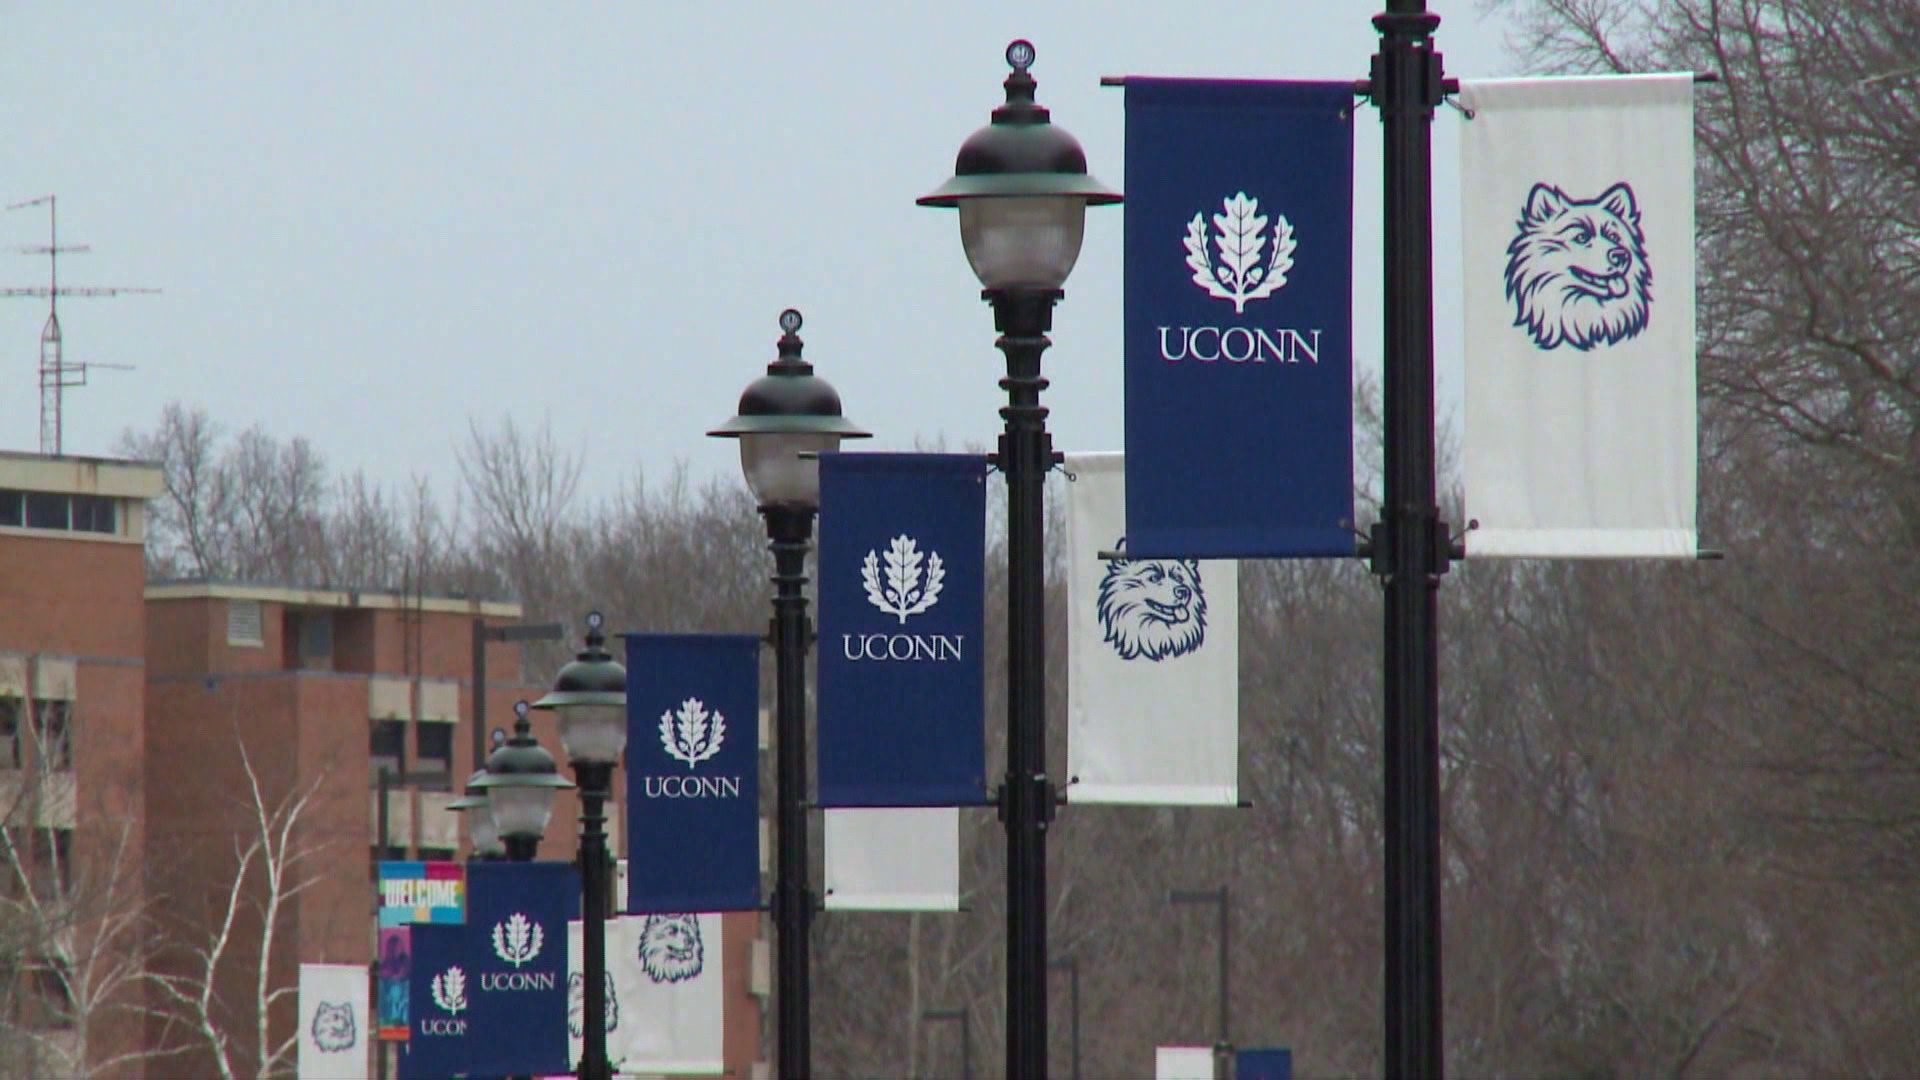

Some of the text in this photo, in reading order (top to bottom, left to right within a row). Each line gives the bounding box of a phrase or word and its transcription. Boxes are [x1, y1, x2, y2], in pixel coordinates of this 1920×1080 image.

[1158, 326, 1321, 363] UCONN
[843, 633, 964, 661] UCONN
[645, 775, 740, 798] UCONN
[385, 879, 458, 907] WELCOME
[481, 973, 555, 991] UCONN
